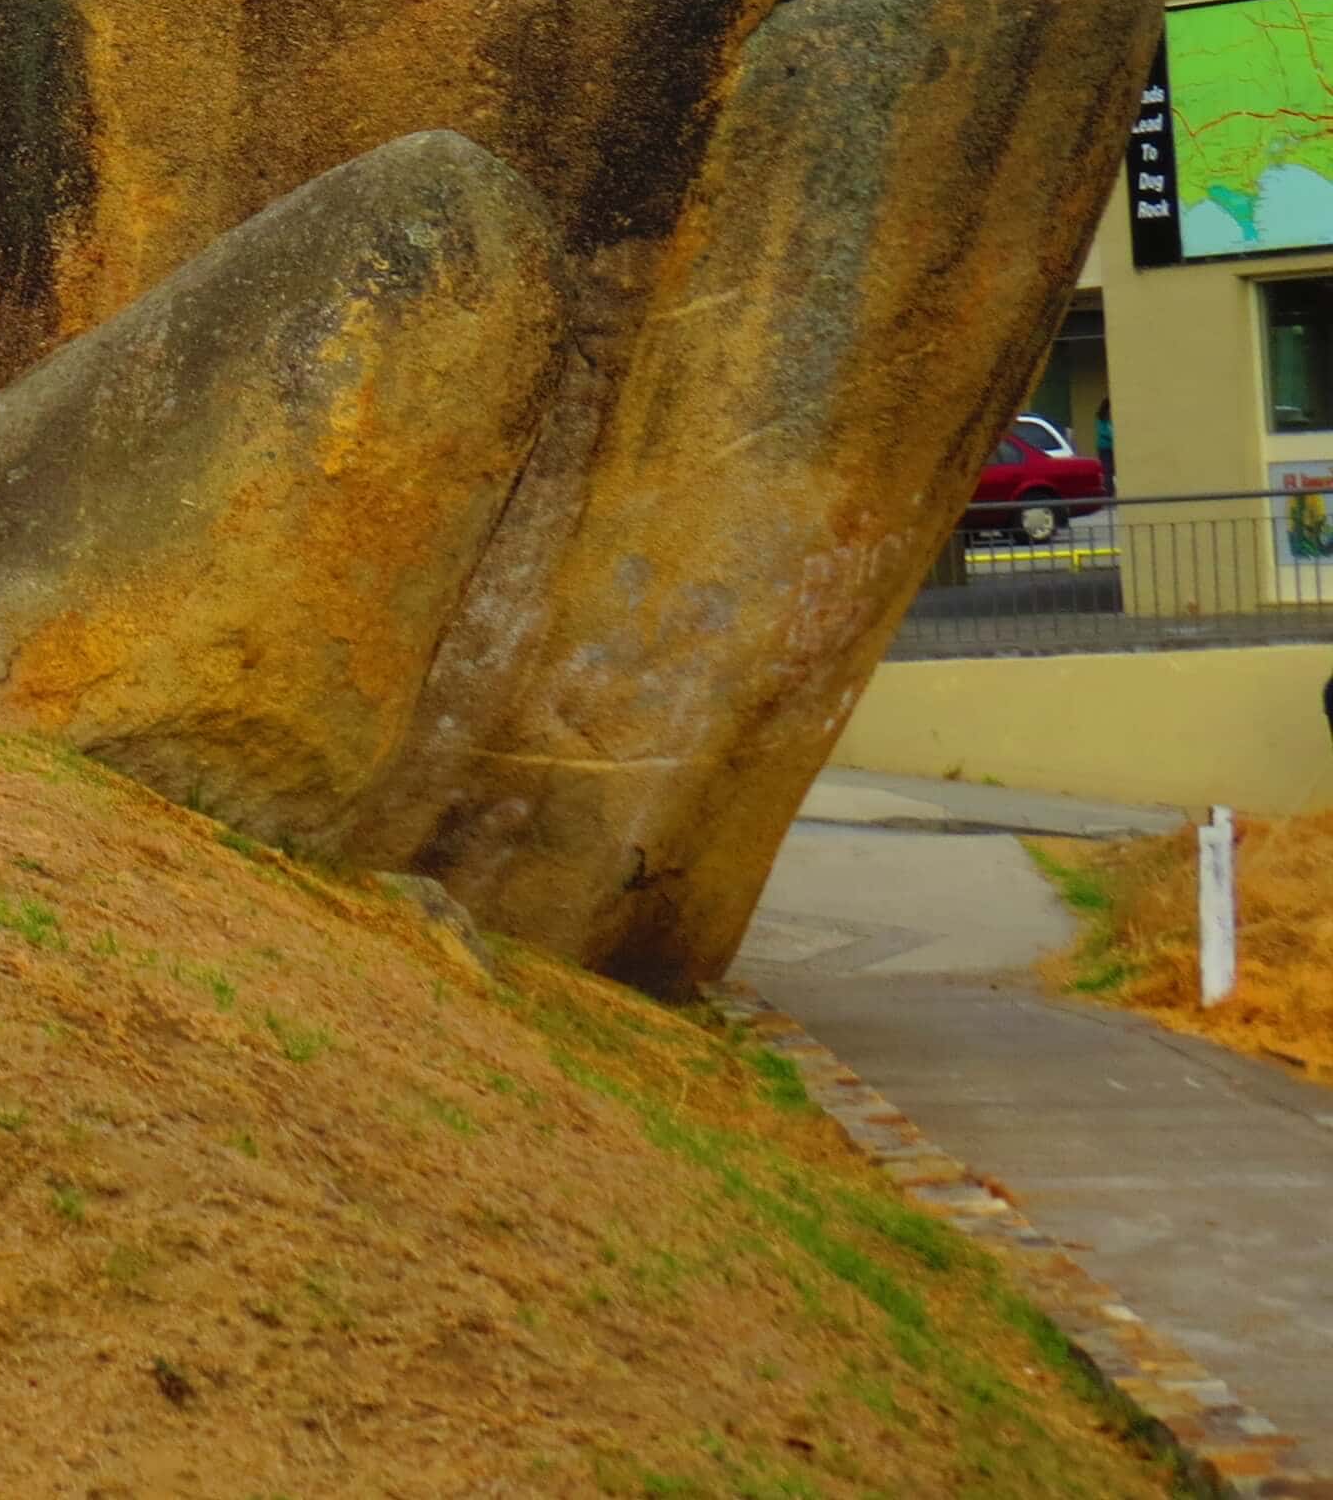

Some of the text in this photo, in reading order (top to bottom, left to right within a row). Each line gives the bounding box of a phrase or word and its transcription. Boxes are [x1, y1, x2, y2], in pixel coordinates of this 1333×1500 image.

[1140, 85, 1165, 104] ads
[1140, 143, 1159, 162] To
[1138, 171, 1165, 193] Dog
[1137, 198, 1171, 219] Rock
